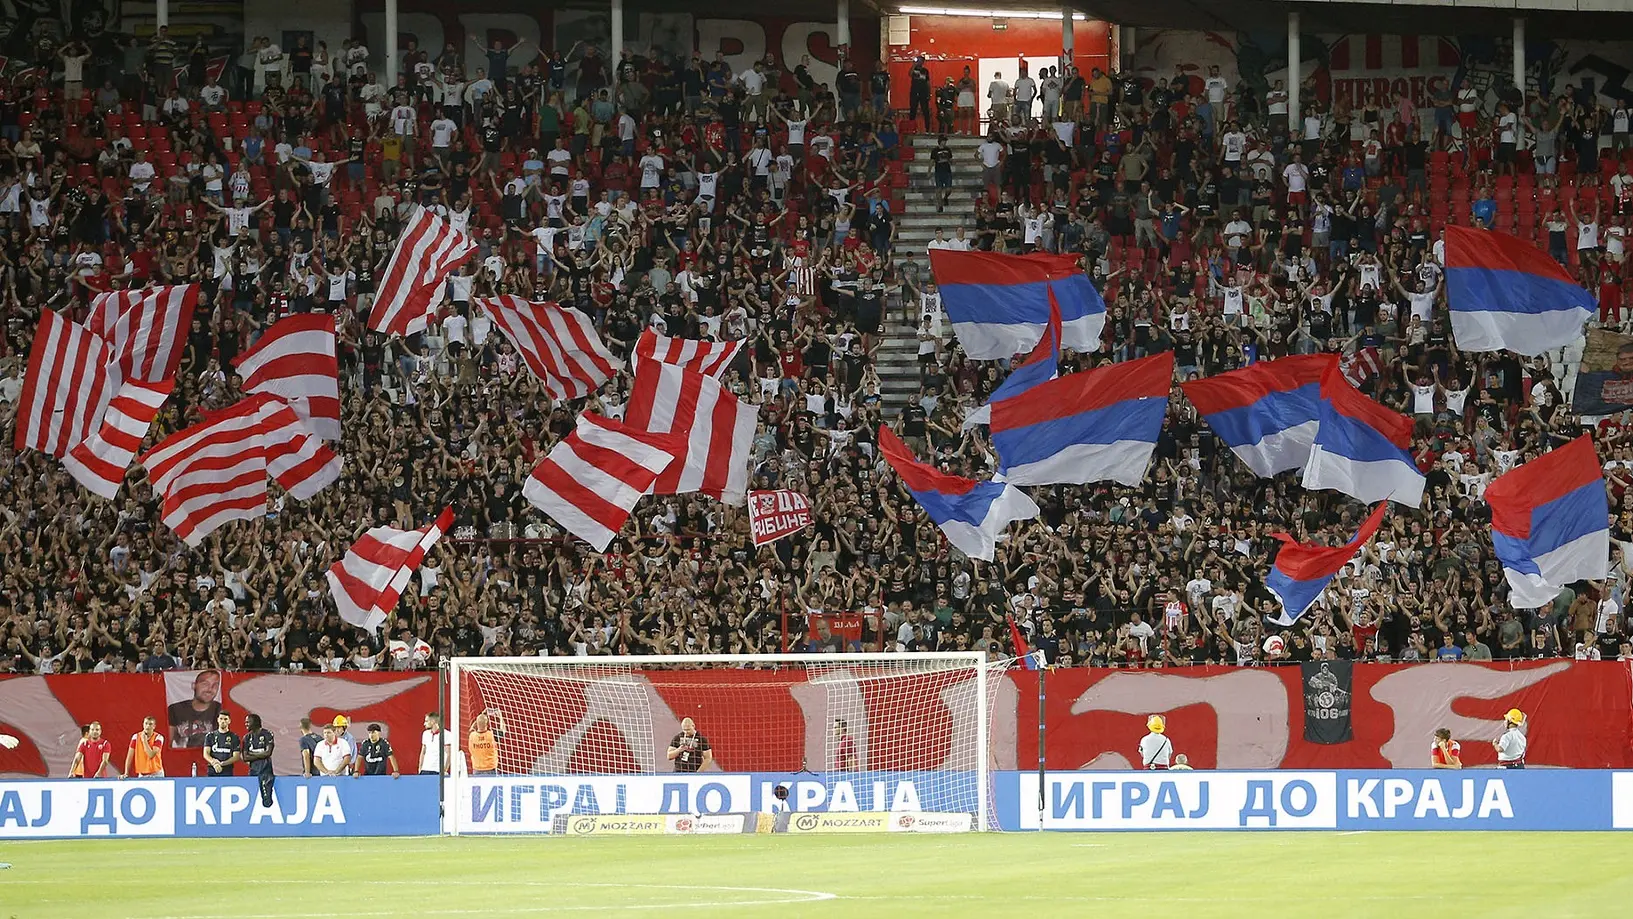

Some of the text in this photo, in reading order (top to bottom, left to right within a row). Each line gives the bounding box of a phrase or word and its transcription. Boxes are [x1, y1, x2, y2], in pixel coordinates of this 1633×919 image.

[1315, 708, 1339, 720] 106
[80, 787, 157, 834] ДО
[185, 785, 346, 825] КРАЈА
[471, 780, 922, 823] ИГРАЈ ДО КРАЈА
[1051, 777, 1514, 827] ИГРАЈ ДО КРАЈА
[600, 822, 659, 830] MOZZART
[822, 818, 884, 827] MOZZART
